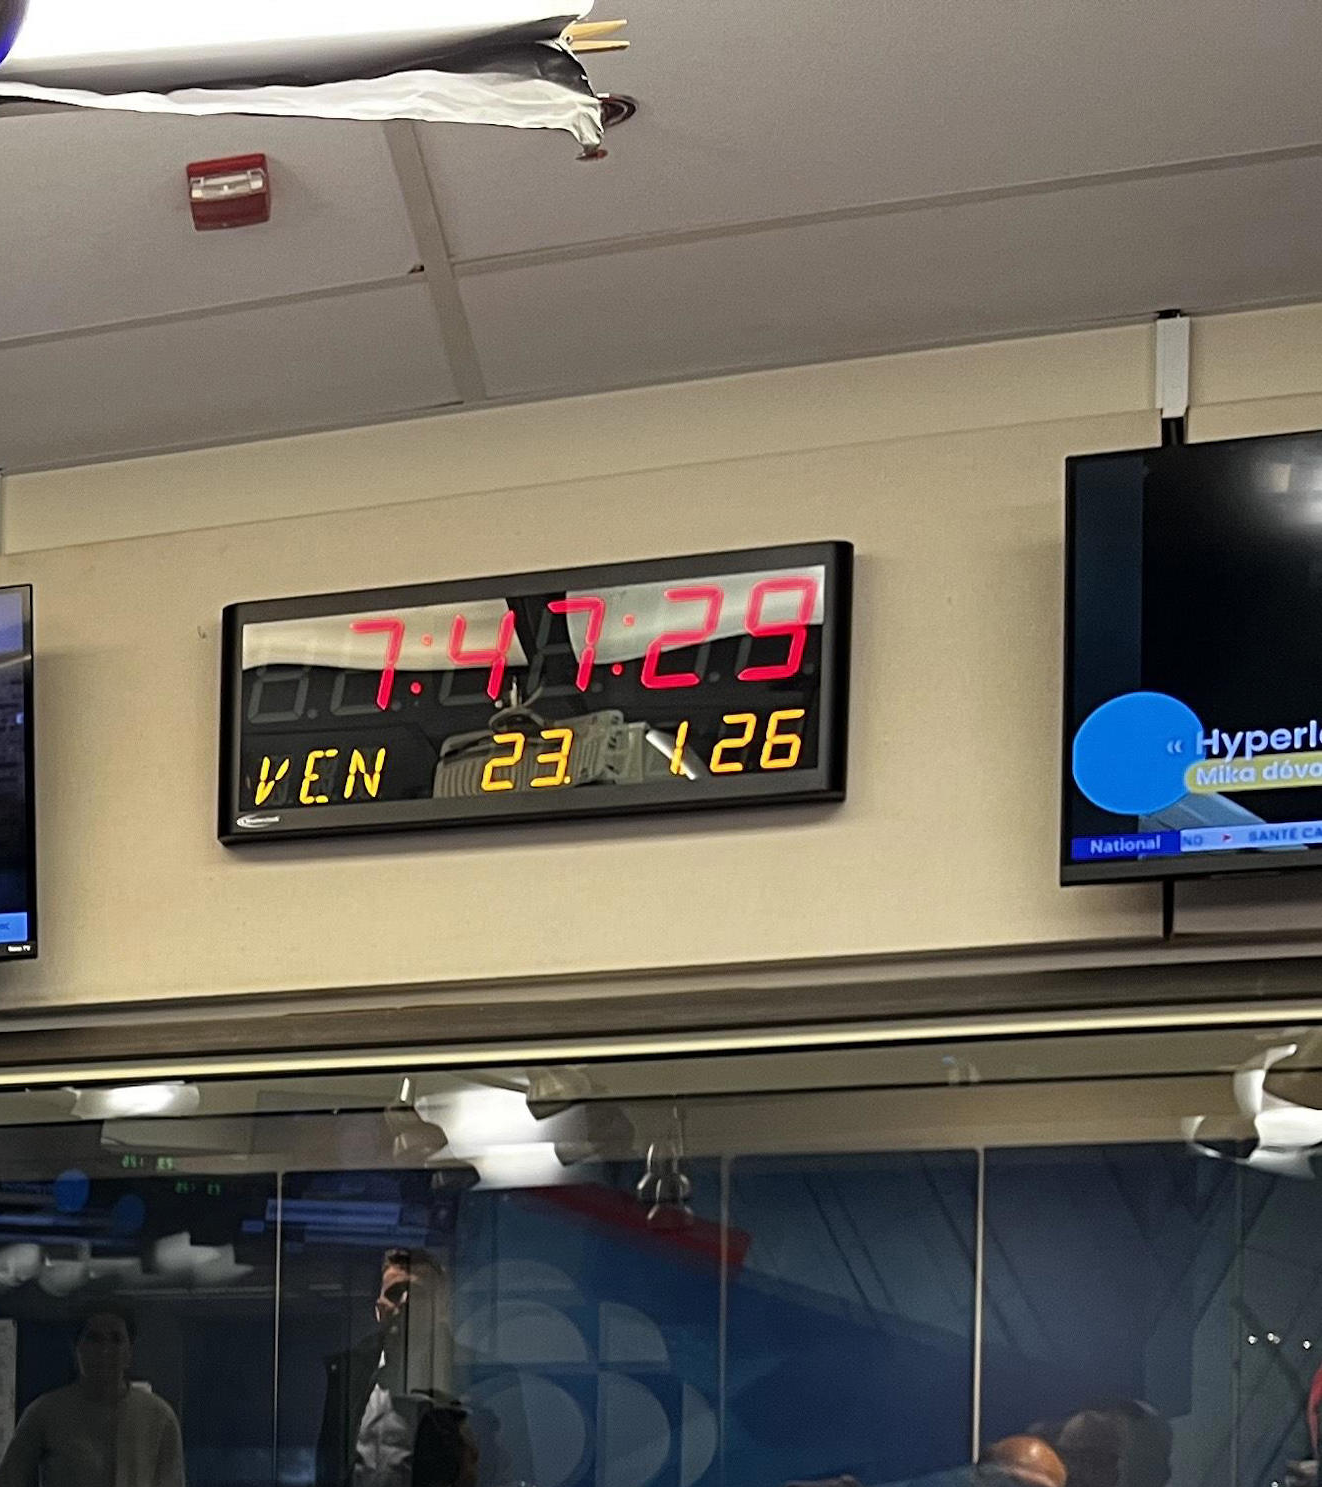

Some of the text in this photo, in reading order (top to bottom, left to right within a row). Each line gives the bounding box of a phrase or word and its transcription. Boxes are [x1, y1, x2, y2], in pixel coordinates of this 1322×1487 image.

[349, 576, 817, 711] 7:47:29
[1196, 720, 1322, 762] Hyperl
[255, 748, 386, 806] VEN
[1196, 764, 1255, 786] Mika
[1090, 835, 1161, 854] National
